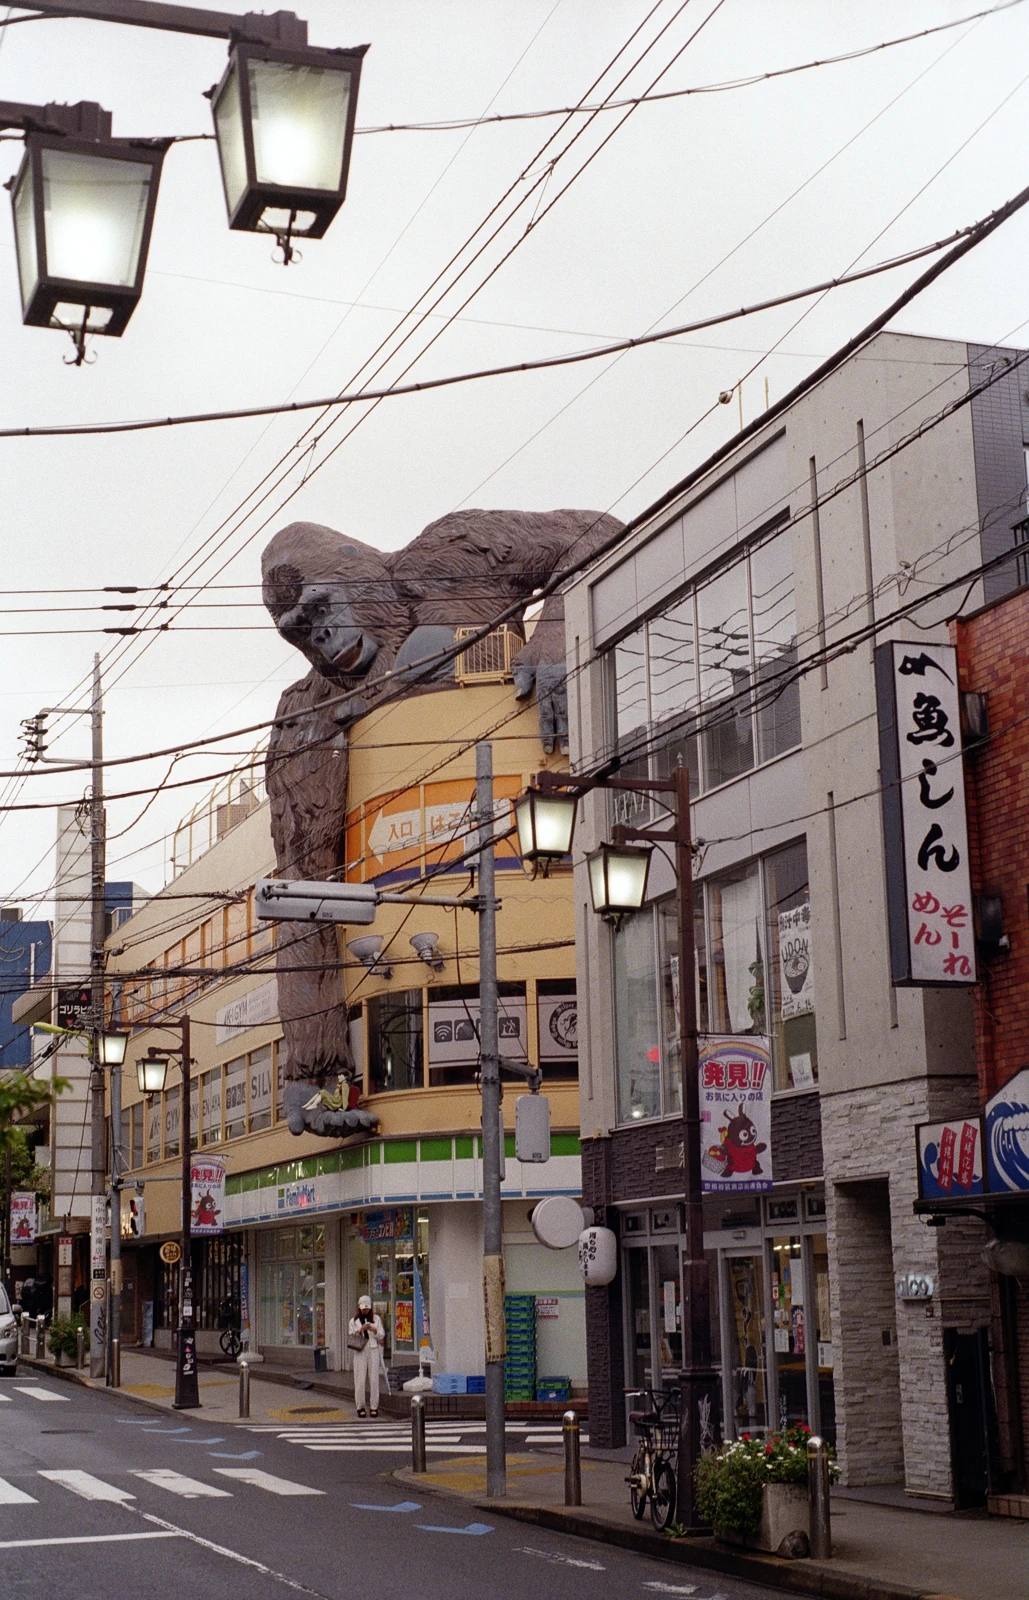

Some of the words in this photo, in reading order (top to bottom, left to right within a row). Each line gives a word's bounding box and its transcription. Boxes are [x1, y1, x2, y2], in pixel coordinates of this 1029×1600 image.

[388, 820, 413, 842] 入口
[912, 891, 942, 946] めん
[781, 937, 809, 963] UDON
[940, 904, 972, 977] そーれ
[251, 1065, 286, 1100] SILVE
[703, 1060, 767, 1090] 発見!!
[705, 1091, 764, 1102] お気に入りの店
[191, 1168, 223, 1183] 発見!!
